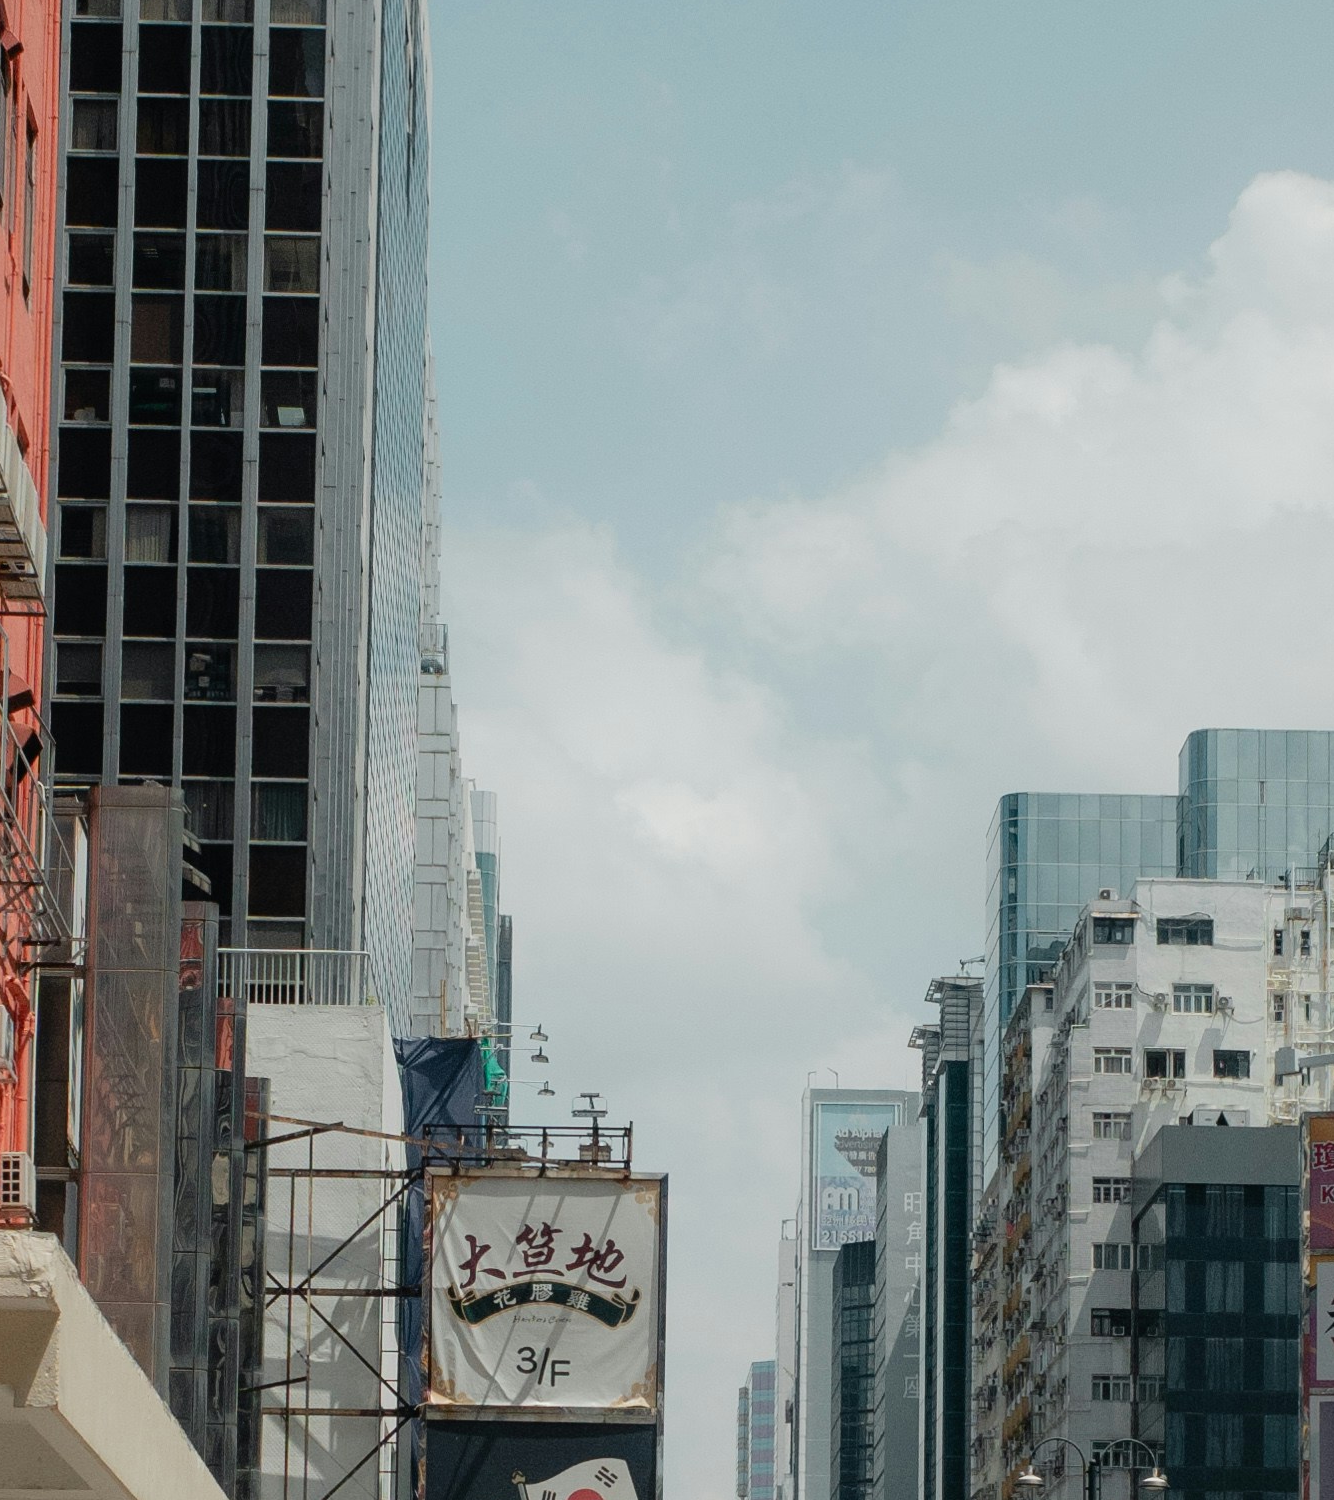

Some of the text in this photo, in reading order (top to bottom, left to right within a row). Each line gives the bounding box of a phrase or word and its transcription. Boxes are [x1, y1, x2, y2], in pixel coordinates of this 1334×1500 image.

[494, 1284, 591, 1310] 花膠雞
[516, 1346, 570, 1386] 3/F
